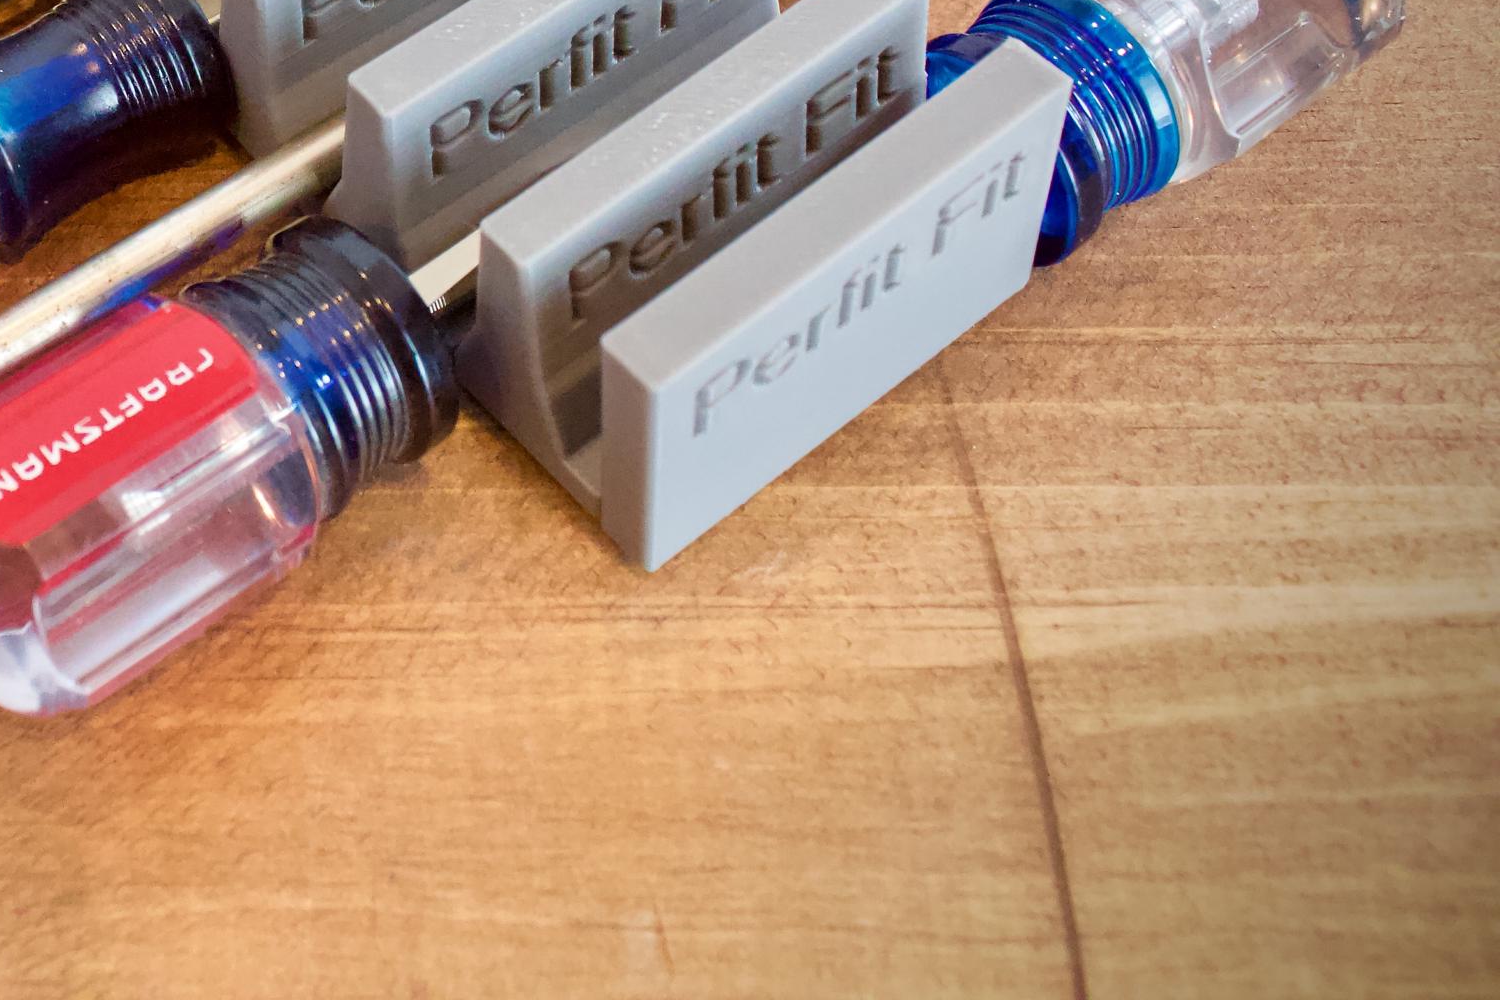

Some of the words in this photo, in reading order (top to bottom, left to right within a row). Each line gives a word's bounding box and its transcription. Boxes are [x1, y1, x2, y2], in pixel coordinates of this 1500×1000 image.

[429, 4, 638, 181] Perfit
[568, 132, 781, 323] Perfit
[804, 45, 901, 158] Fit
[692, 242, 908, 438] Perfit
[930, 150, 1026, 257] Fit
